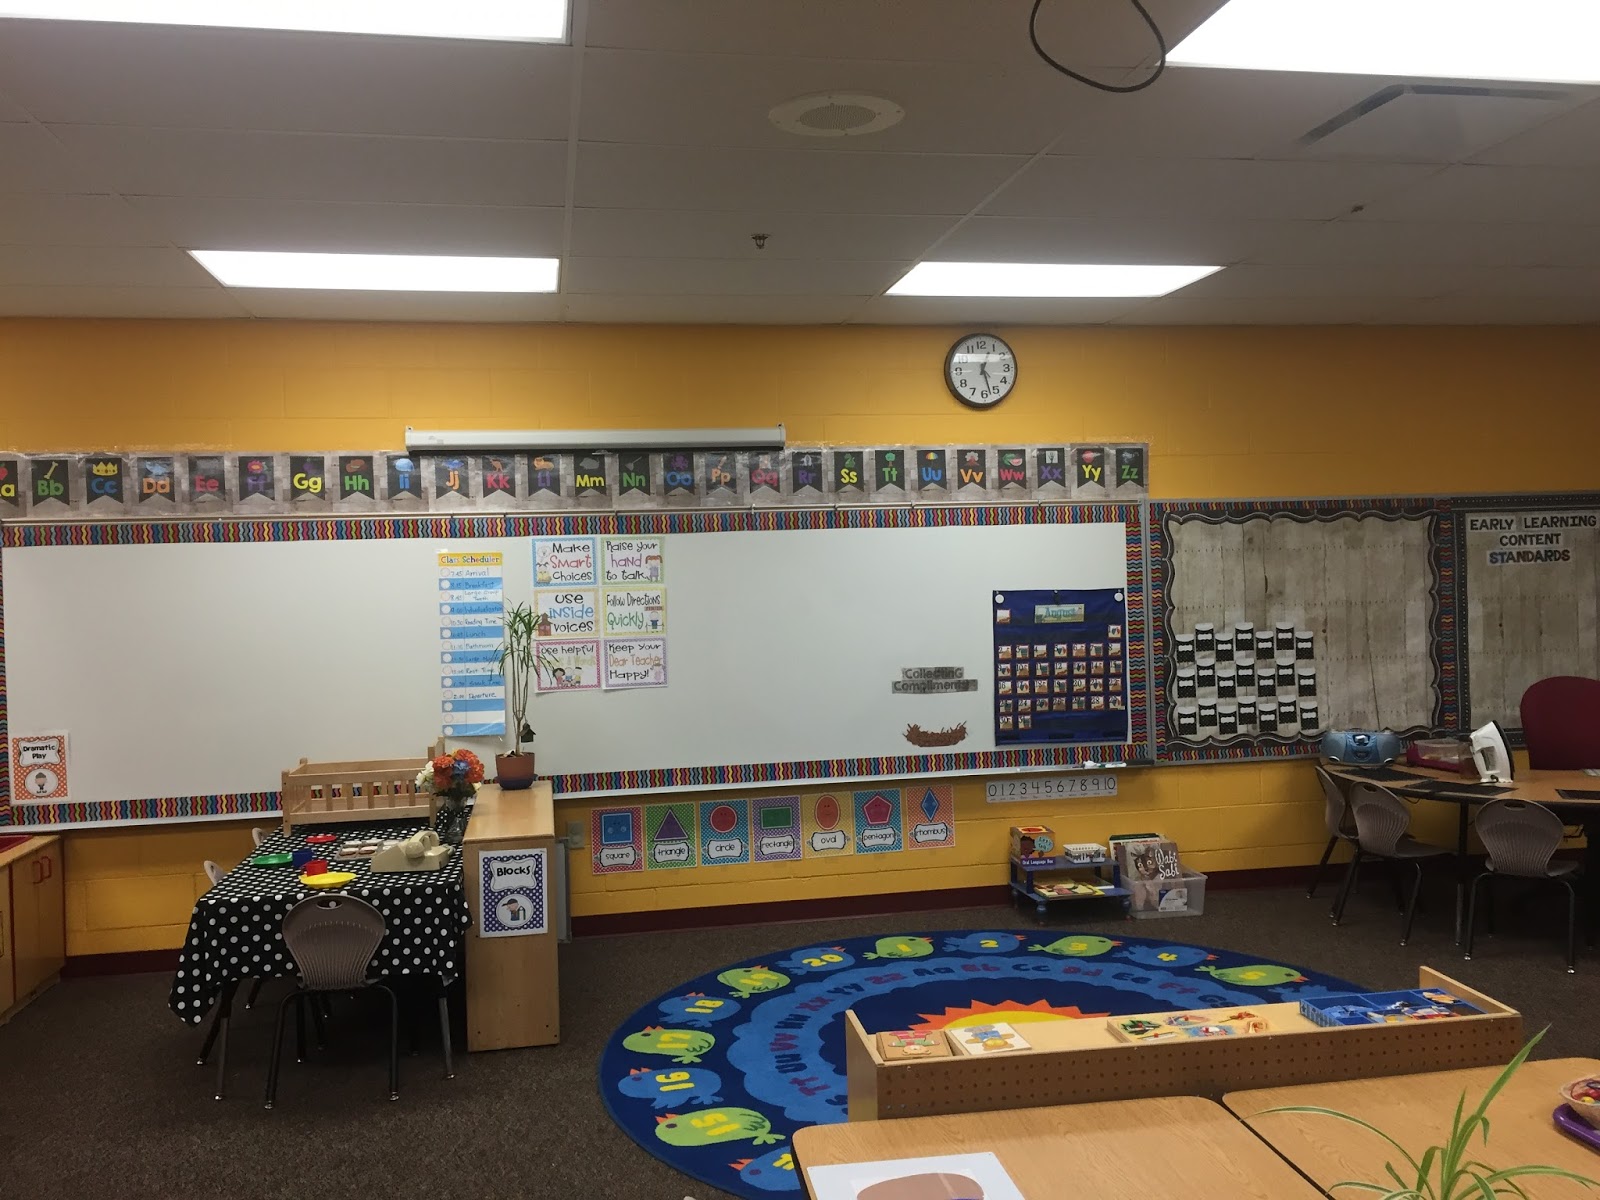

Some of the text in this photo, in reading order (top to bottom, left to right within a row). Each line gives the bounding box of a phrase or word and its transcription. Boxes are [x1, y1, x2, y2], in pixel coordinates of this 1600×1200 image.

[967, 345, 974, 354] 11
[976, 341, 987, 350] 12
[992, 343, 996, 352] 1
[1003, 364, 1011, 373] 3
[959, 379, 967, 388] 8
[1000, 376, 1007, 385] 4
[969, 387, 977, 396] 7
[981, 390, 988, 399] 6
[992, 385, 1000, 395] 5
[0, 481, 15, 497] a
[37, 479, 64, 496] Bb
[91, 478, 118, 494] Cc
[142, 476, 170, 495] Dd
[194, 475, 219, 493] Ee
[247, 476, 268, 492] Ff
[293, 473, 322, 493] Gg
[344, 475, 370, 491] Hh
[445, 471, 460, 491] Jj
[486, 473, 510, 489] Kk
[575, 474, 605, 488] Mm
[622, 472, 646, 488] Nn
[665, 471, 692, 487] Oo
[711, 469, 731, 485] Pp
[751, 469, 778, 487] Qq
[797, 469, 817, 484] Rr
[840, 469, 858, 484] Ss
[882, 467, 899, 483] Tt
[921, 467, 943, 482] Uu
[959, 467, 984, 483] Vv
[999, 466, 1025, 481] Ww
[1040, 465, 1063, 480] Xx
[1081, 463, 1102, 482] Yy
[1121, 464, 1139, 481] Zz
[1470, 515, 1597, 531] EARLY LEARNING
[1499, 532, 1562, 547] CONTENT
[552, 543, 590, 553] Make
[606, 541, 657, 553] Raise your
[441, 555, 460, 564] Class
[1489, 549, 1571, 564] STANDARDS
[465, 567, 489, 577] Arrival
[606, 569, 617, 580] to
[606, 594, 625, 607] Follow
[1044, 607, 1076, 620] August
[607, 611, 644, 630] Quickly
[553, 620, 593, 632] voices
[561, 644, 594, 656] helpful
[608, 654, 628, 666] Dear
[631, 653, 662, 666] Teacher
[609, 669, 649, 681] Happy!
[23, 744, 55, 752] Dramatic
[988, 784, 997, 797] 0
[1009, 783, 1016, 796] 2
[1020, 782, 1027, 795] 3
[1031, 781, 1040, 794] 4
[1044, 780, 1053, 794] 5
[1056, 780, 1065, 793] 6
[1069, 779, 1076, 792] 7
[1080, 778, 1088, 791] 8
[1091, 778, 1100, 790] 9
[1104, 777, 1116, 790] 10
[916, 827, 946, 837] rhombus
[820, 835, 837, 844] oval
[863, 832, 894, 843] pentagon
[715, 843, 736, 852] circle
[762, 839, 794, 849] rectangle
[605, 852, 631, 861] square
[657, 847, 686, 858] triangle
[1154, 848, 1177, 865] Wabi
[1030, 858, 1046, 866] Language
[496, 865, 531, 877] Blocks
[1158, 862, 1180, 880] Sabi
[896, 943, 913, 952] 1
[979, 939, 999, 948] 2
[1068, 942, 1088, 952] 3
[802, 953, 844, 967] 20
[1157, 952, 1178, 962] 4
[1239, 970, 1267, 980] 5
[655, 1071, 695, 1092] 16
[690, 1112, 742, 1137] 15
